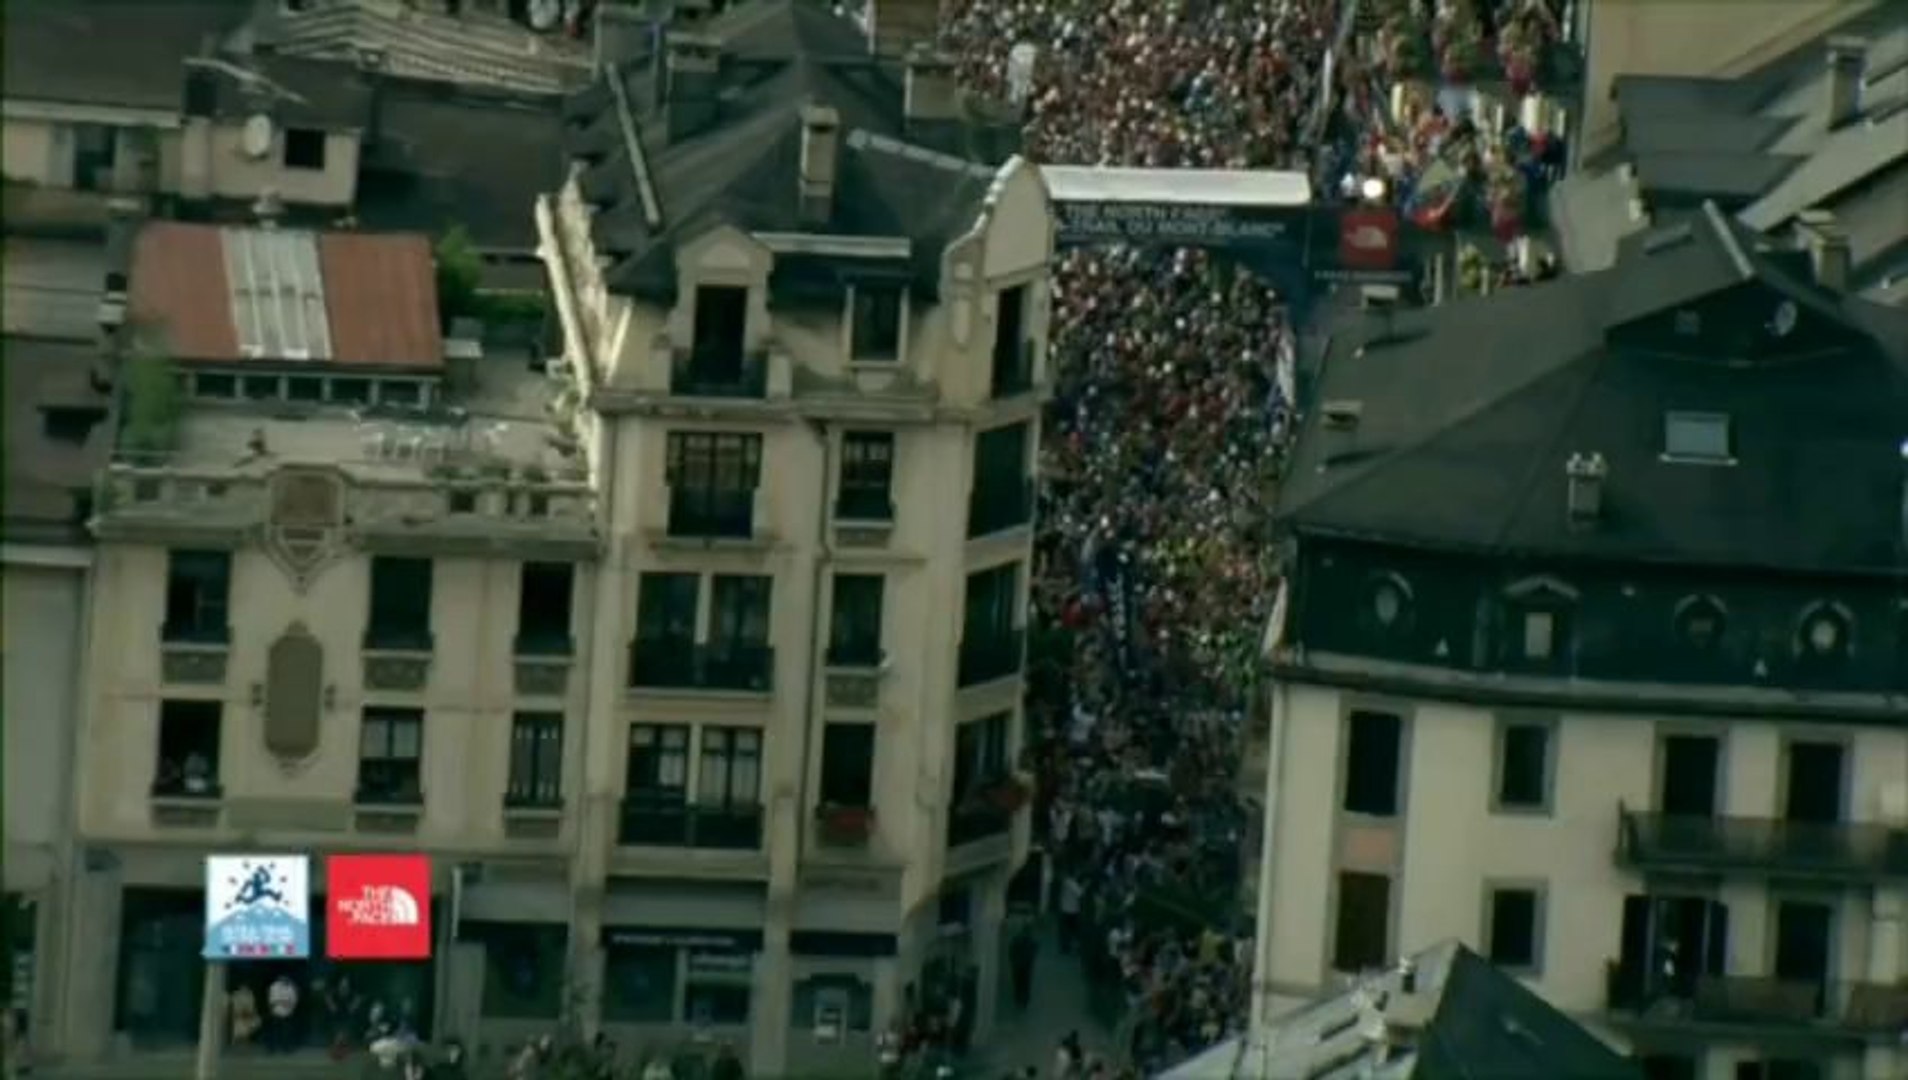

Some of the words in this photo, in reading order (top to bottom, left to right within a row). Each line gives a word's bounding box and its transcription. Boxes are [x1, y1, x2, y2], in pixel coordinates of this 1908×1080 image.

[1066, 205, 1098, 217] THE
[1103, 206, 1165, 218] NORTH
[1127, 220, 1152, 235] DU
